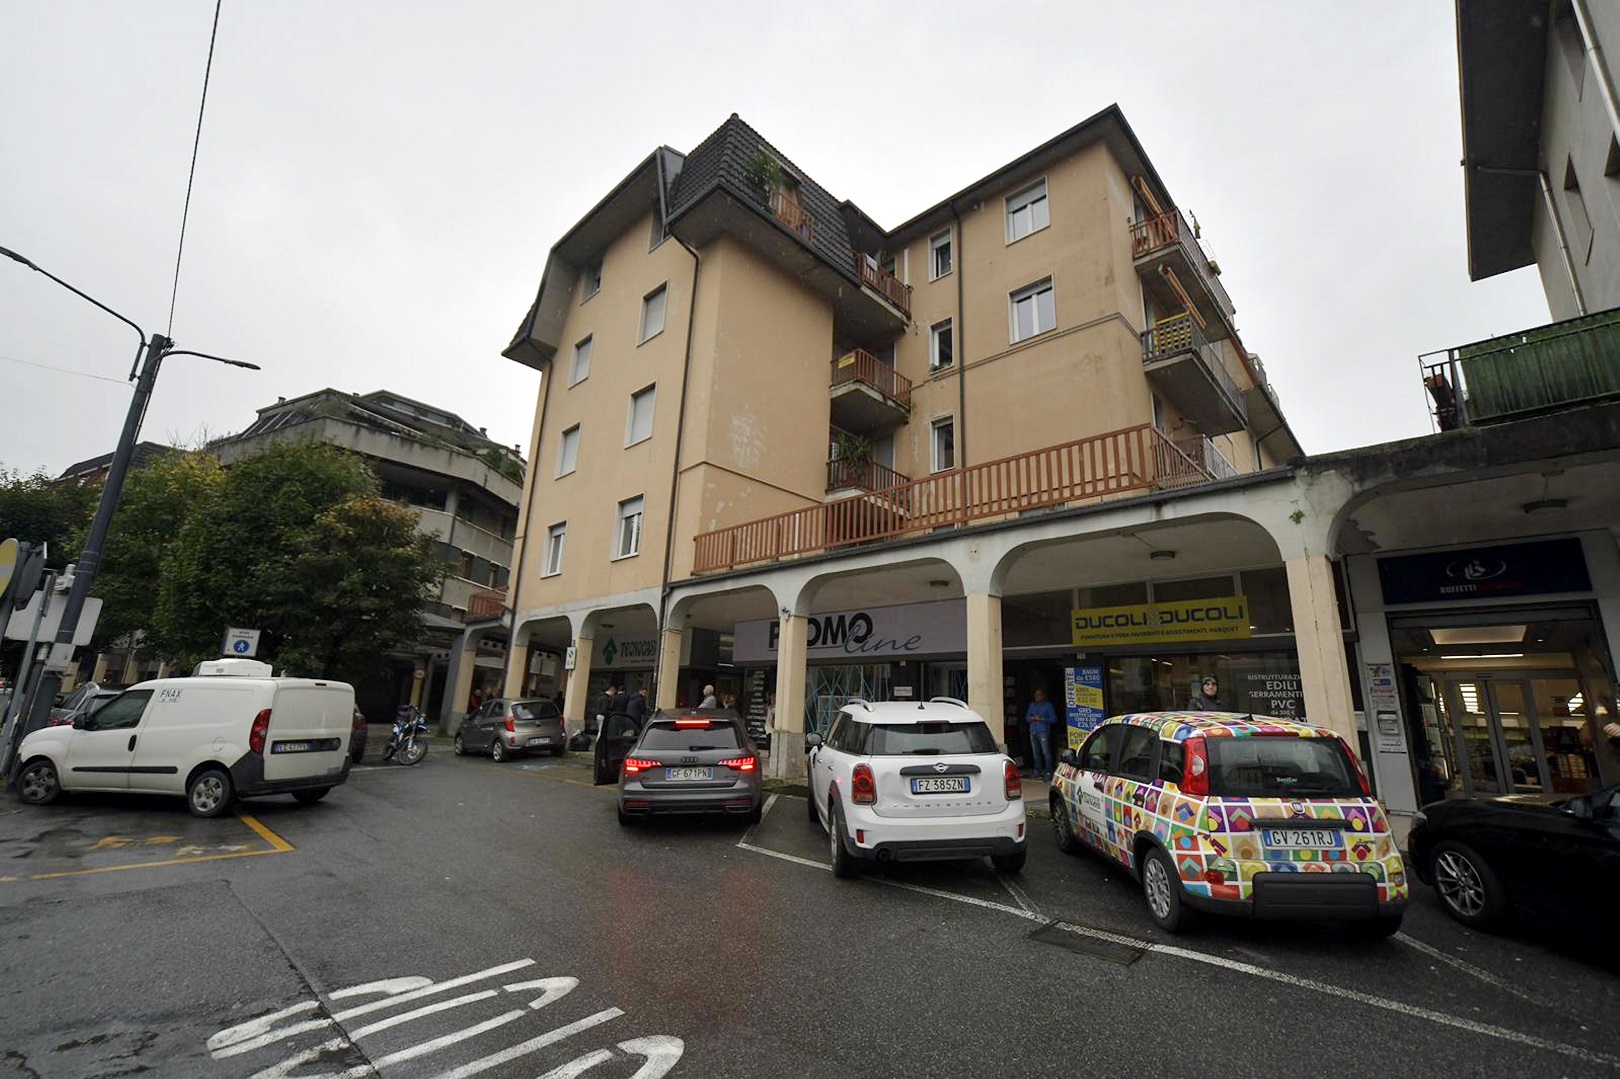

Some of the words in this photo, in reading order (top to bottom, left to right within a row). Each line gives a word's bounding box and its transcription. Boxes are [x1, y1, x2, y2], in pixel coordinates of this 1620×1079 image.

[1075, 611, 1147, 630] DUCOLI
[1159, 604, 1243, 624] DUCOLI
[768, 612, 874, 649] POMO
[843, 624, 922, 654] line
[1067, 670, 1076, 707] OFFERTE
[1266, 681, 1297, 690] EDILI
[1248, 690, 1303, 698] SERRAMENTI
[1271, 699, 1296, 709] PVC
[1069, 731, 1089, 739] PORT
[672, 769, 681, 778] GF
[683, 768, 707, 778] 671PN
[918, 780, 930, 790] FZ
[934, 779, 964, 790] 385ZN
[1272, 831, 1288, 845] GV
[1293, 831, 1334, 845] 261RJ
